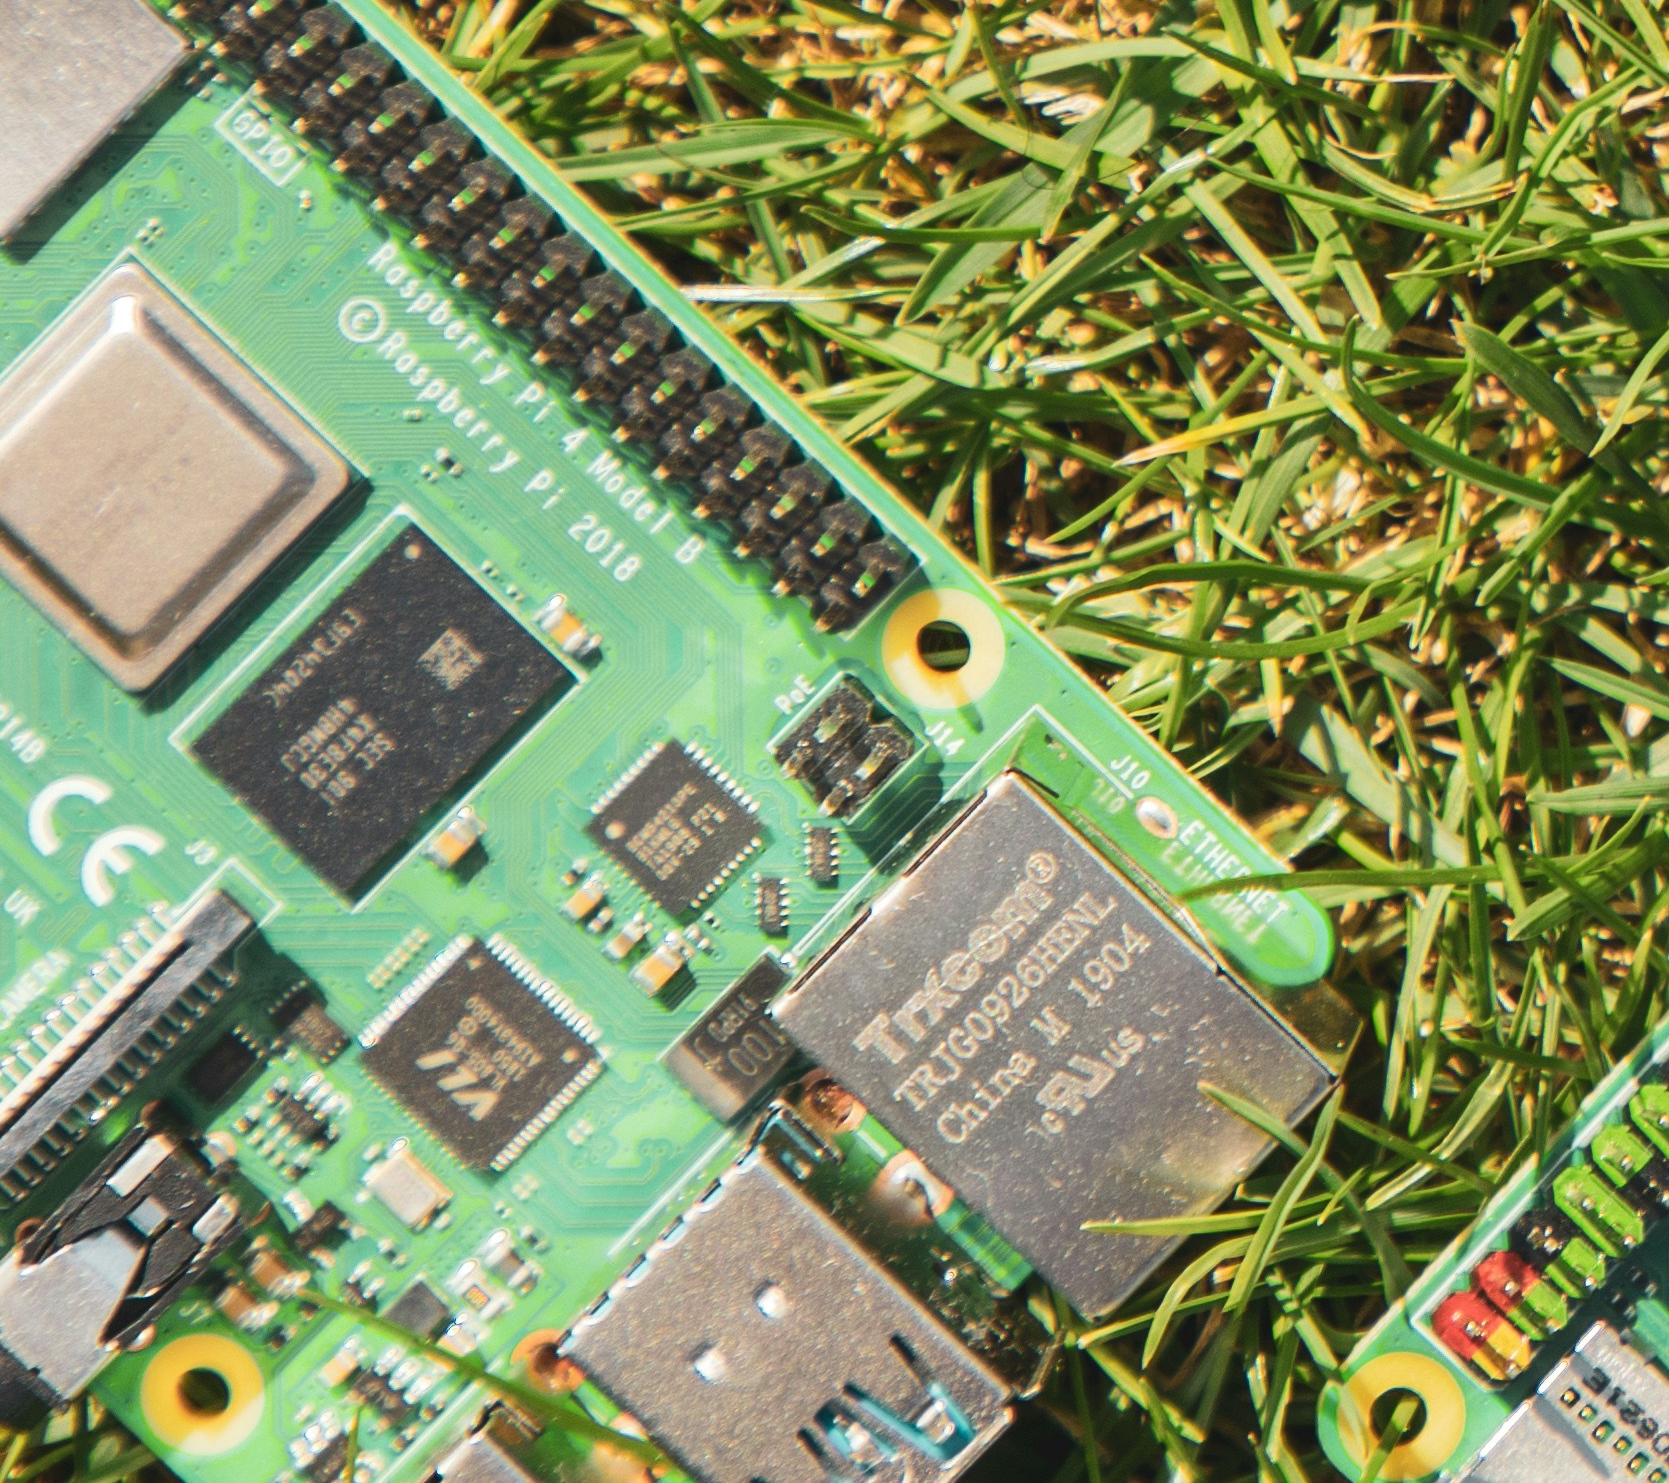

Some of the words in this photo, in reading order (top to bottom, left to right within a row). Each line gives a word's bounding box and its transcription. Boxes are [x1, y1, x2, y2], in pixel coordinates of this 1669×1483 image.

[231, 109, 298, 170] GPIO
[367, 239, 511, 387] Raspberry
[514, 381, 557, 424] Pi
[585, 450, 675, 535] Model
[674, 535, 704, 566] B
[523, 468, 567, 511] Pi
[567, 512, 643, 583] 2018
[1110, 754, 1151, 790] J10
[935, 1048, 1037, 1146] China
[1068, 922, 1154, 1010] 1904
